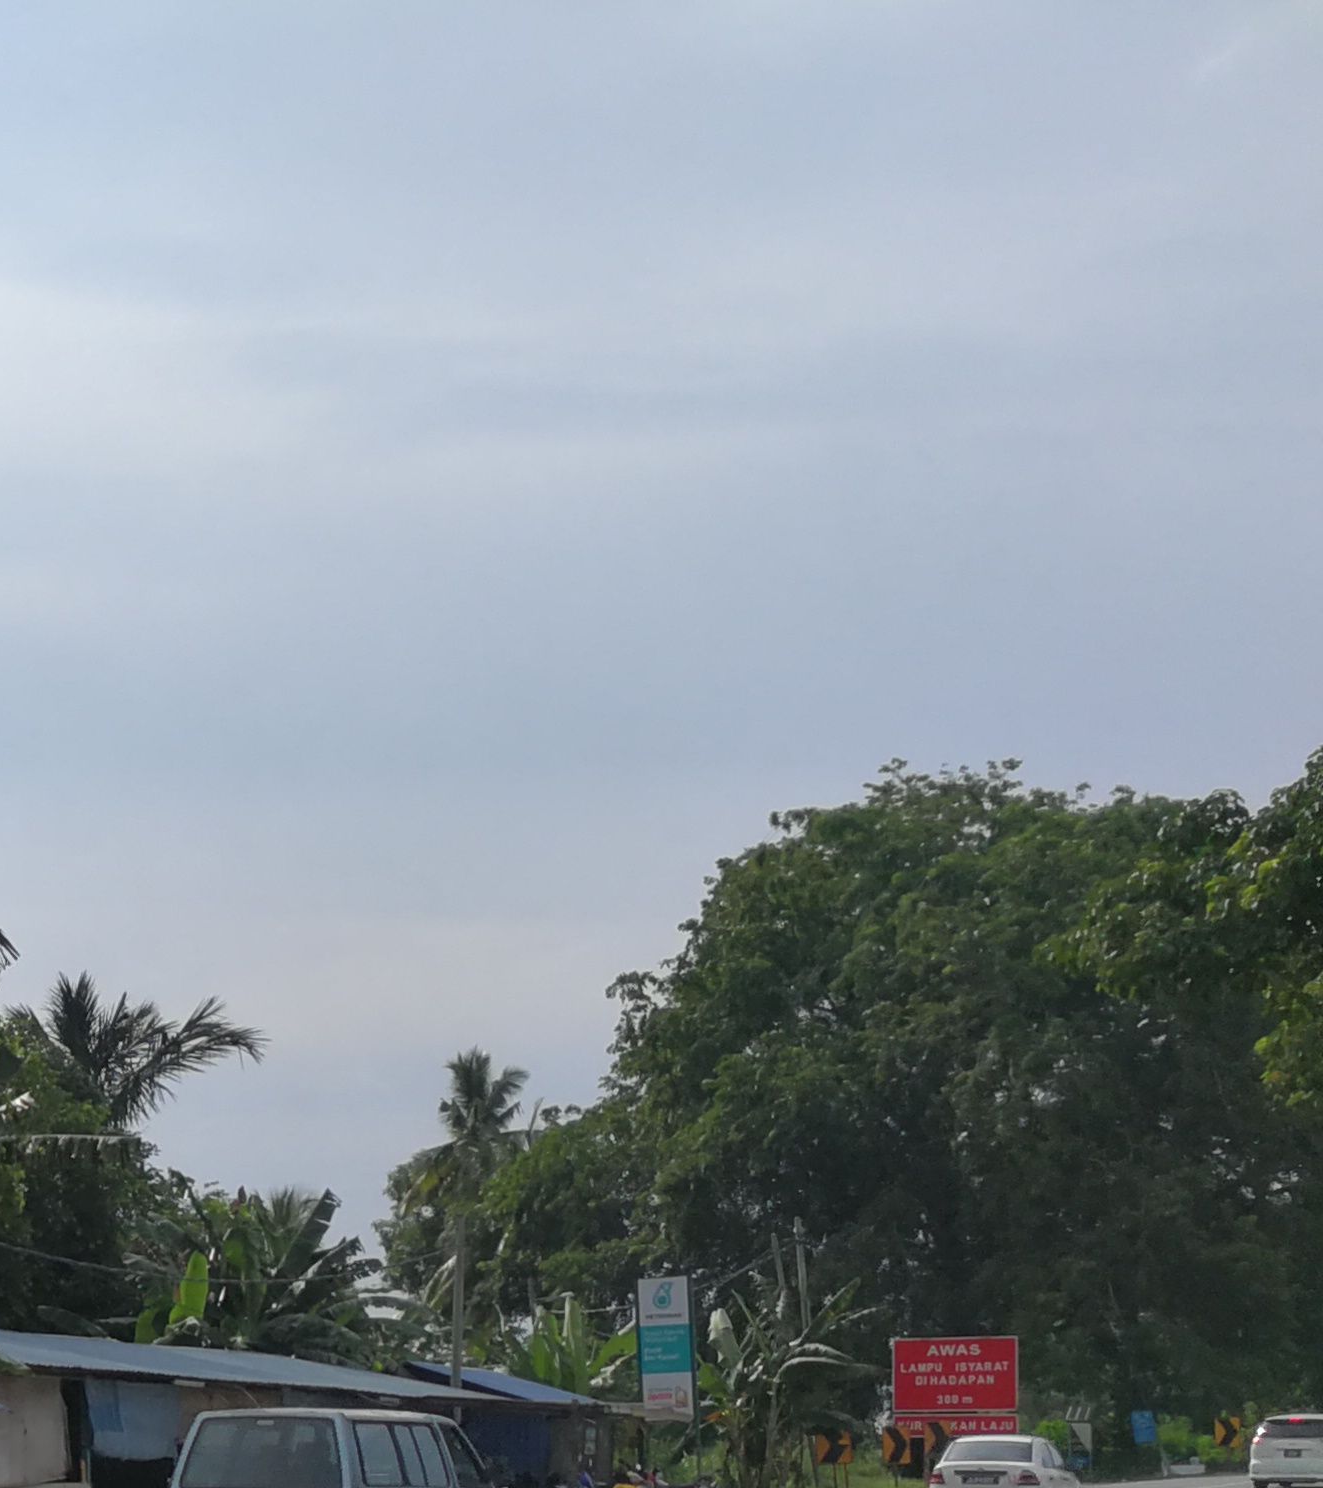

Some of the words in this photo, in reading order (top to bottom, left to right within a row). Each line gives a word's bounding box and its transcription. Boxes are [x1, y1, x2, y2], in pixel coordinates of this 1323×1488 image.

[927, 1344, 981, 1356] AWAS
[900, 1362, 943, 1373] LAMPU
[954, 1361, 1009, 1372] ISYARAT
[980, 1420, 1014, 1431] LAJU
